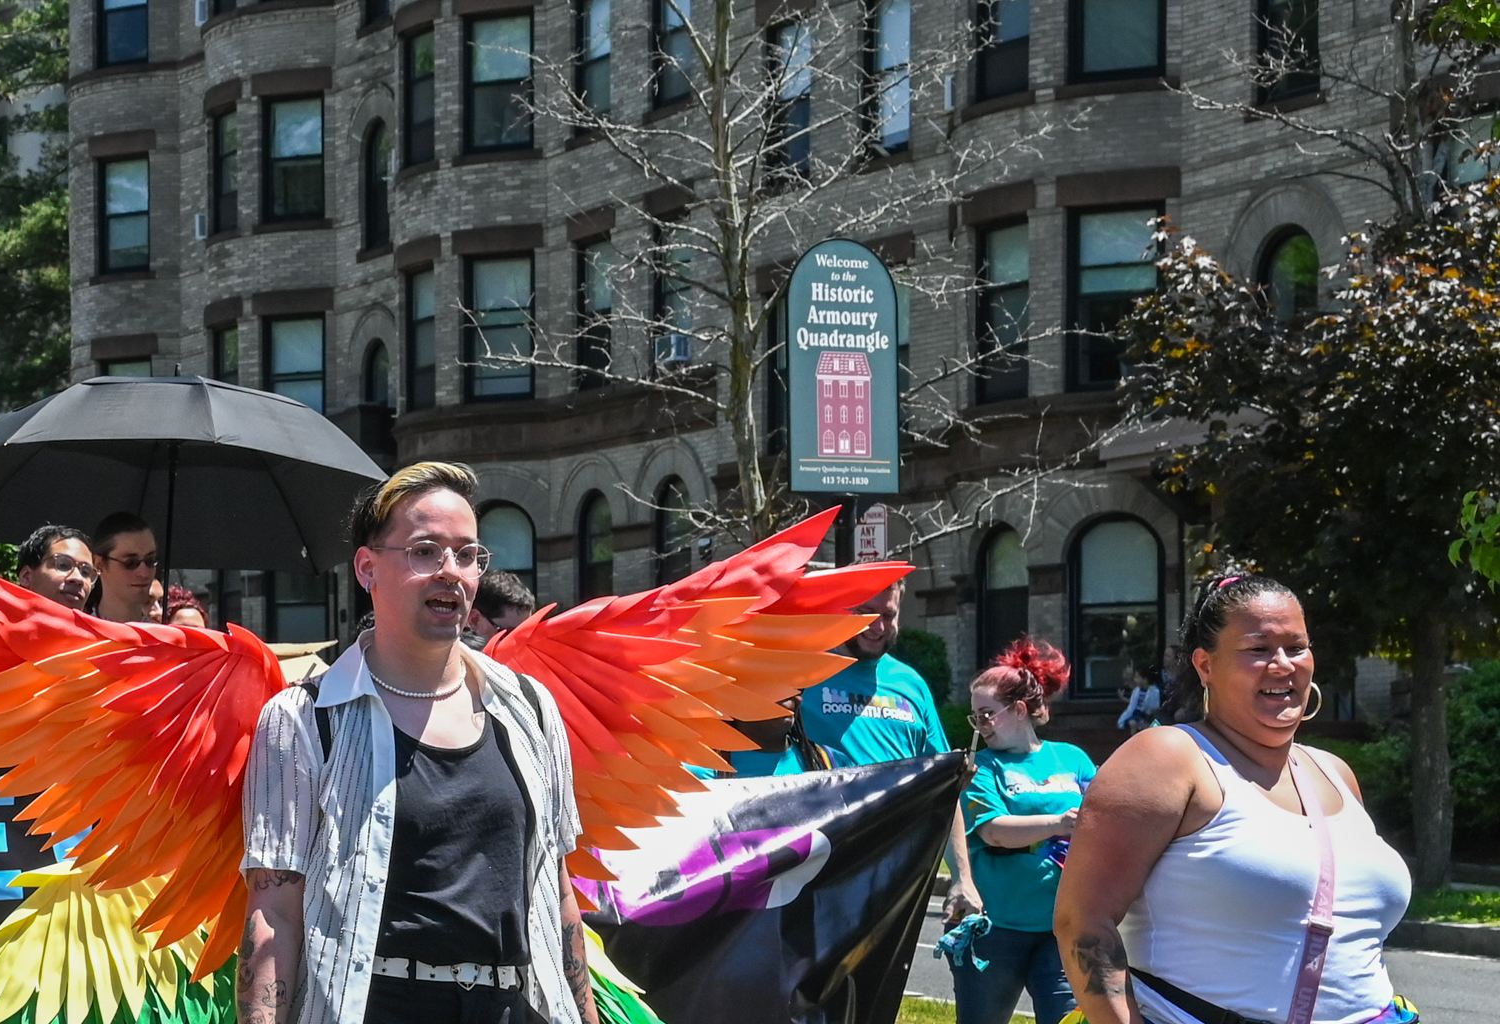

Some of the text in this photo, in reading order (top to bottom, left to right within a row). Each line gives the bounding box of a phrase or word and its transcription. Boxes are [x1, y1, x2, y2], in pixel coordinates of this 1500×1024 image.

[815, 253, 869, 269] Welcome
[831, 270, 857, 282] to the
[811, 282, 874, 304] Historic
[807, 304, 878, 330] Armoury
[796, 326, 889, 353] Quadrangle
[821, 476, 835, 484] 413
[861, 525, 876, 537] ANY
[860, 537, 877, 549] TIME
[822, 703, 853, 714] ROAR
